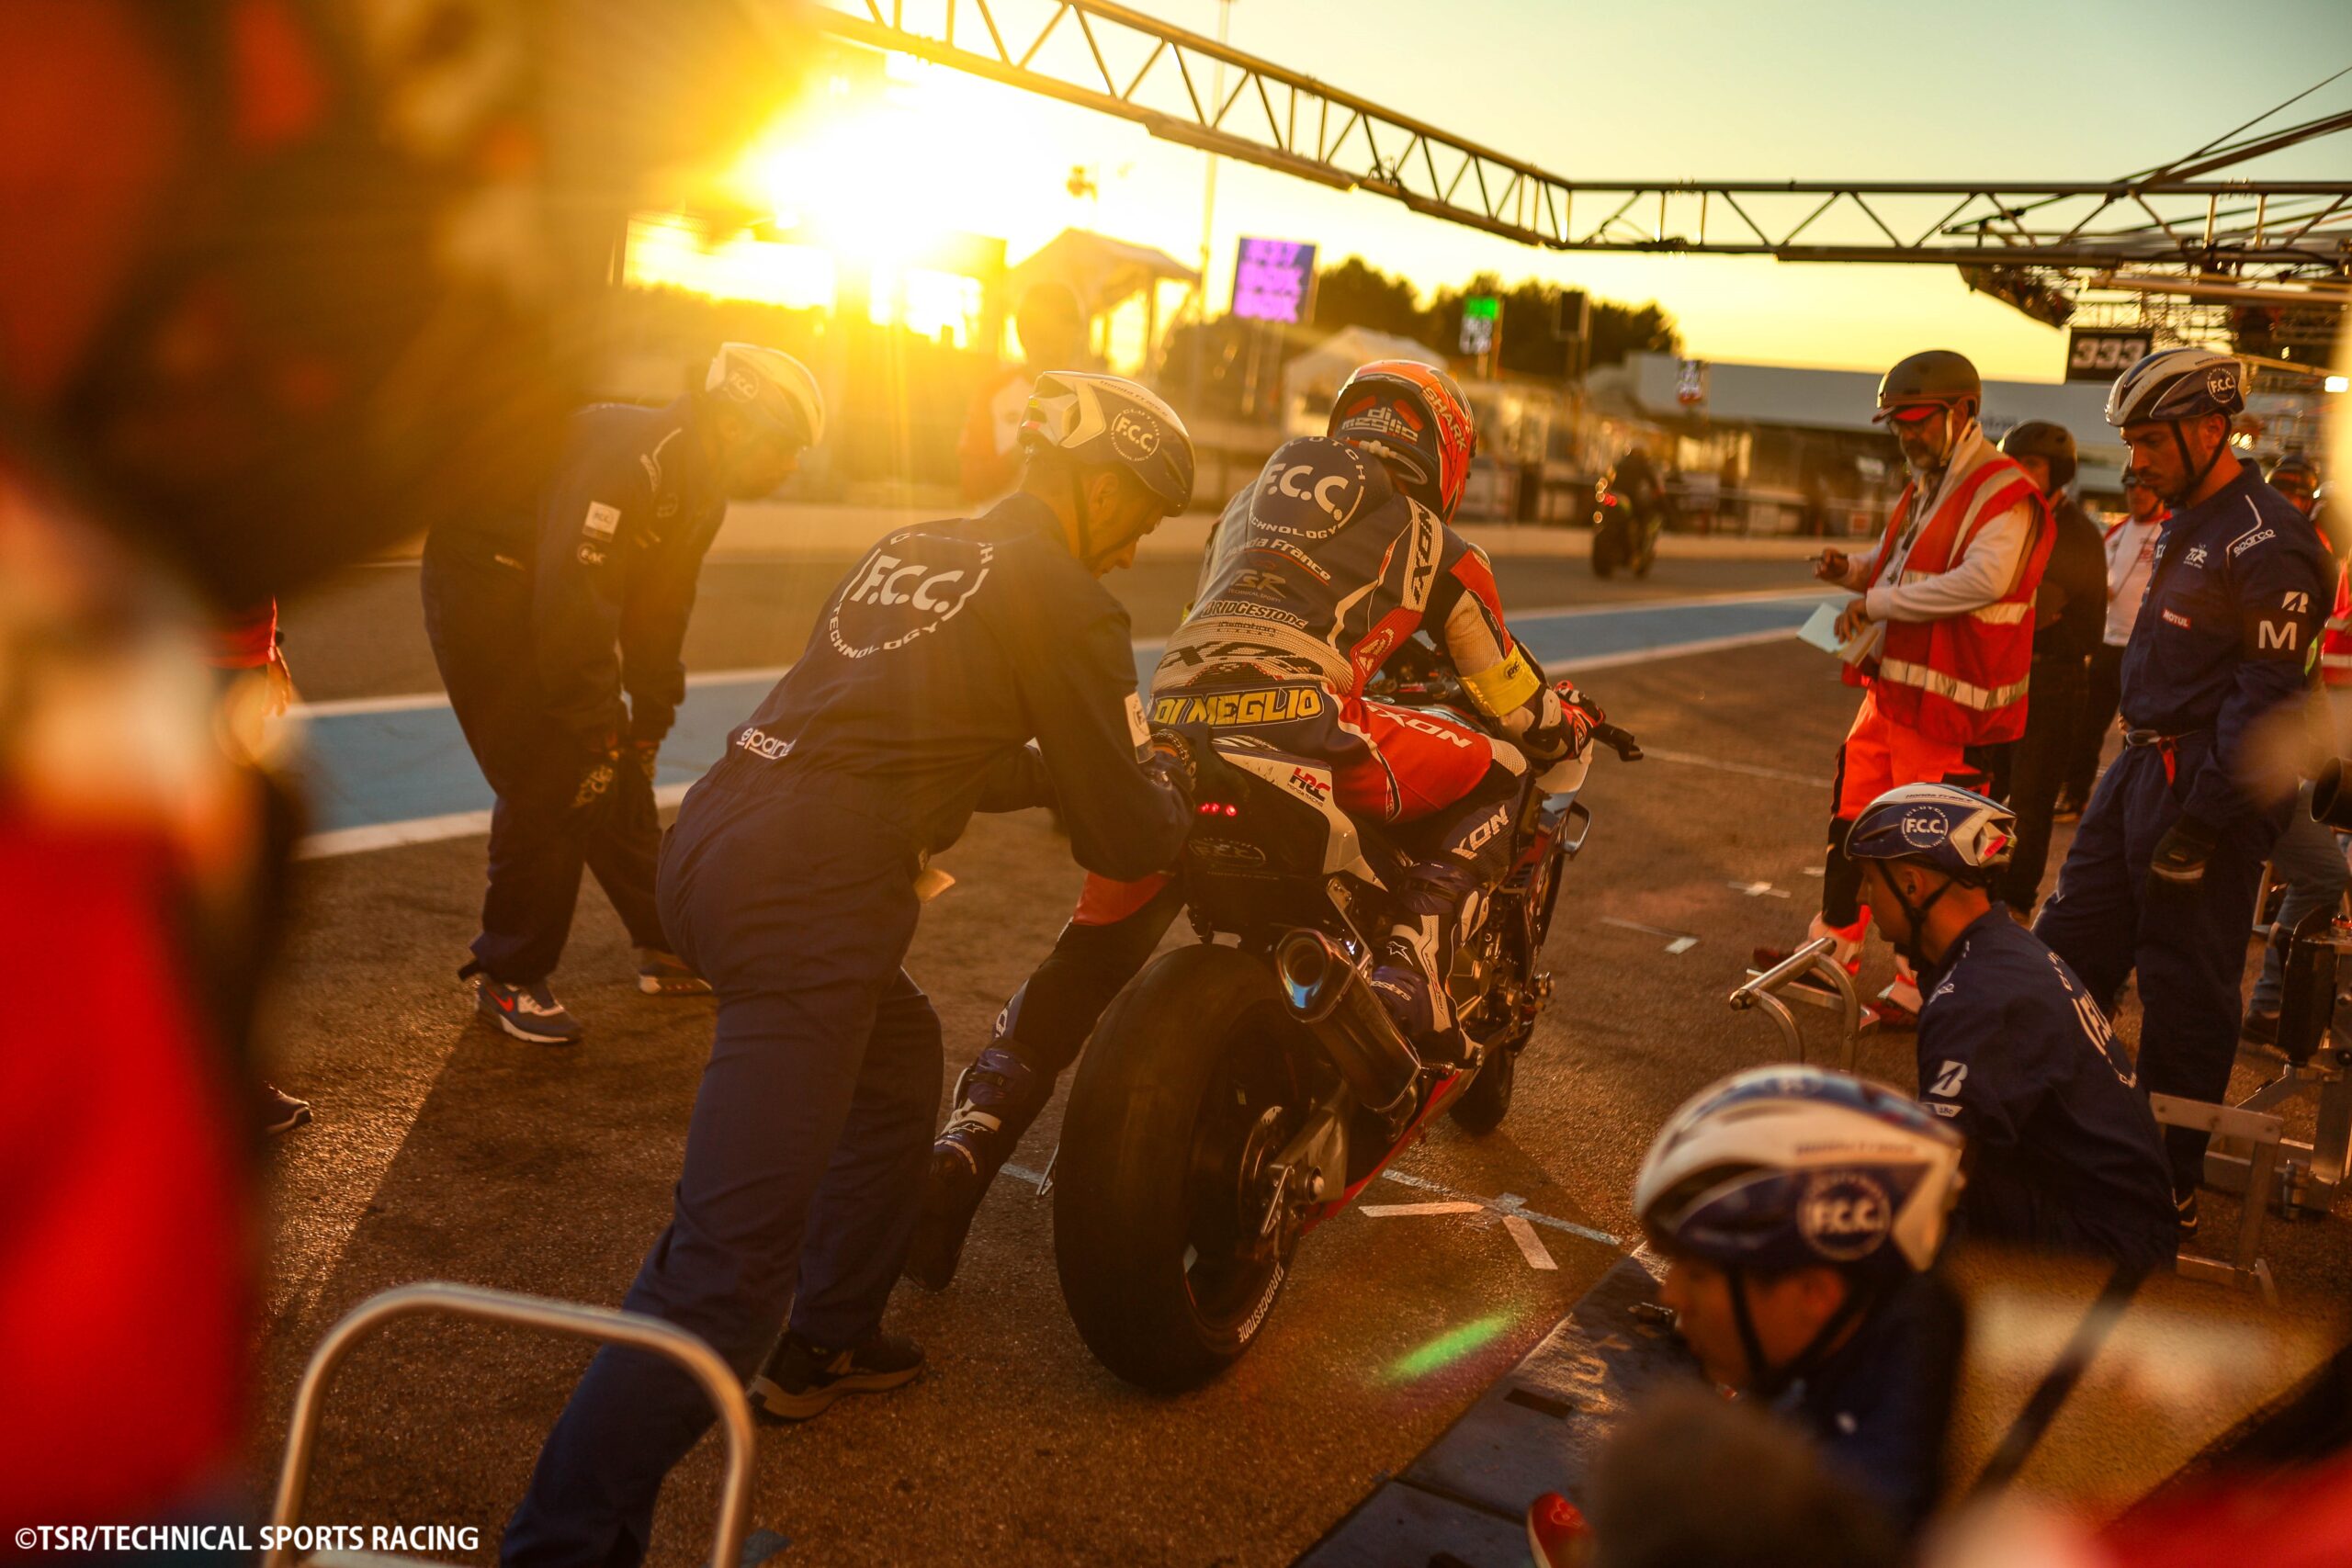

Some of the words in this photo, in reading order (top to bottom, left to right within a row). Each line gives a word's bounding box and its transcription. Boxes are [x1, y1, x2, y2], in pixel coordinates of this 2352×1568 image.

[2073, 338, 2147, 368] 333
[1367, 407, 1393, 421] di
[1424, 386, 1467, 452] SHARK
[1342, 417, 1419, 442] meglio
[1270, 538, 1331, 581] France
[2162, 609, 2189, 627] MOTUL
[2258, 620, 2298, 650] M
[1154, 698, 1186, 725] DI
[1187, 689, 1321, 726] MEGLIO
[1289, 767, 1331, 802] HRC
[1906, 818, 1944, 834] F.C.C.
